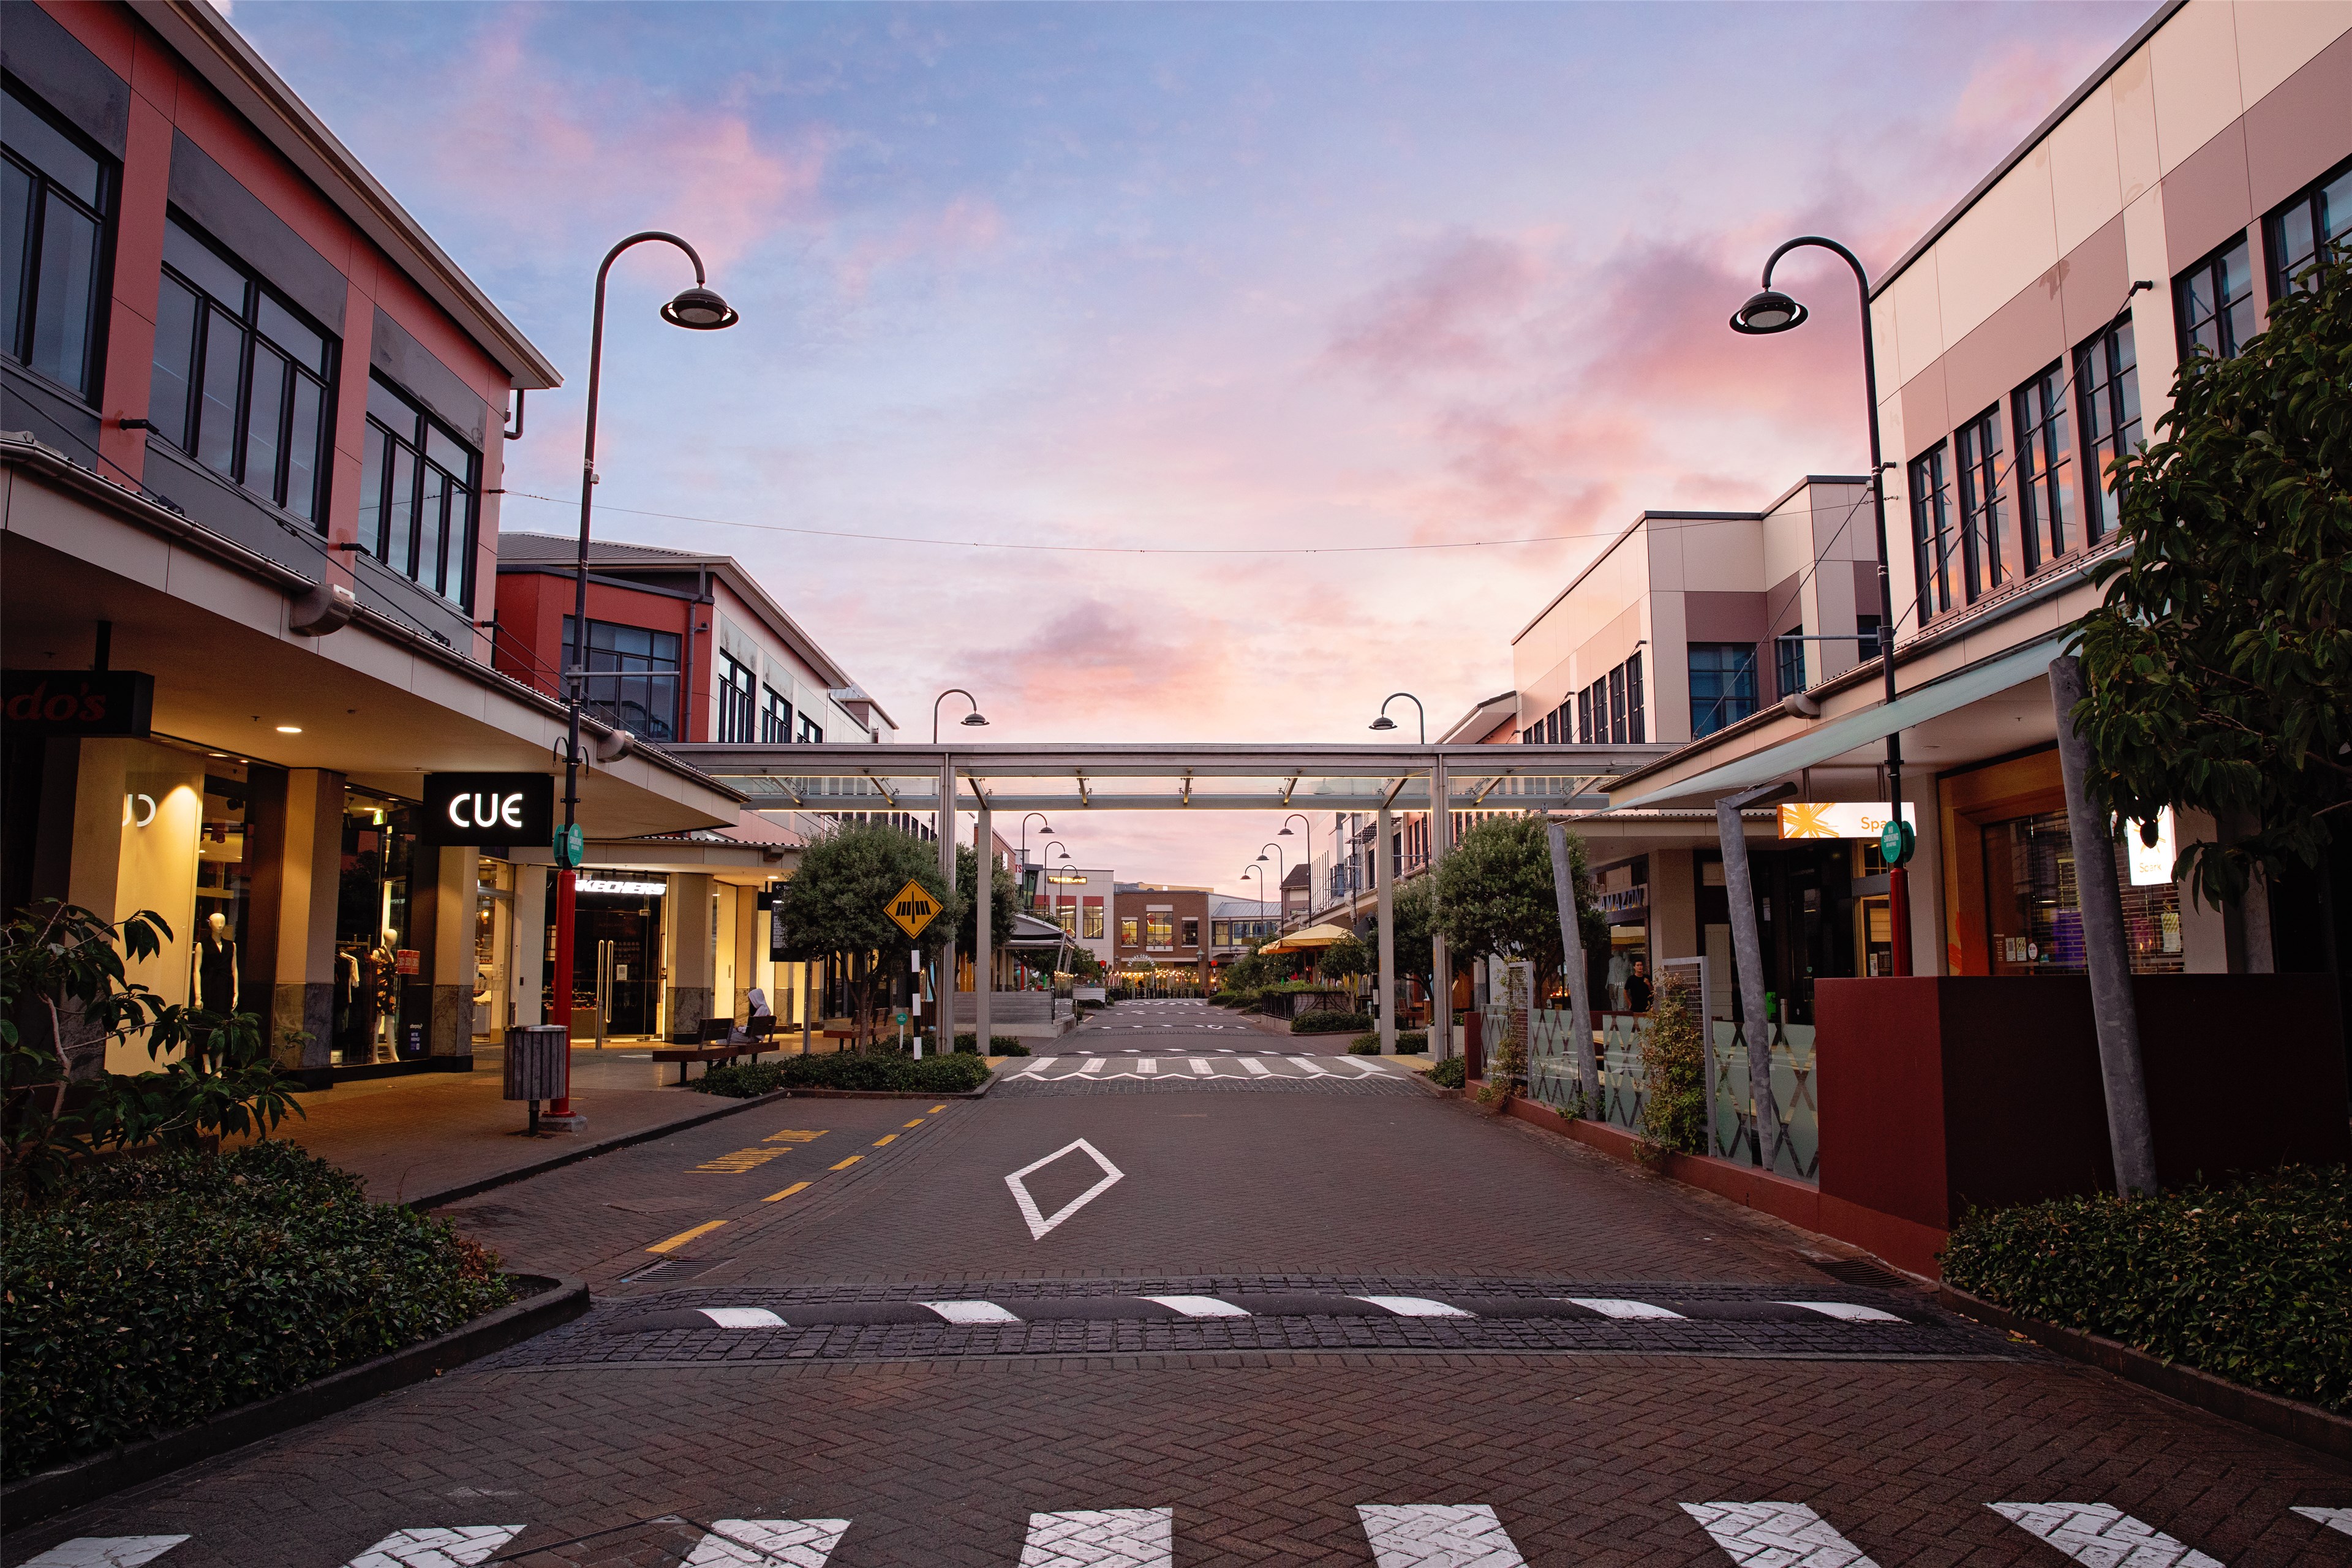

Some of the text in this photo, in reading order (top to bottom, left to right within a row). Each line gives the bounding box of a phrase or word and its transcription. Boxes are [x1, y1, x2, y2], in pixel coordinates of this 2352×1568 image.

[0, 680, 107, 722] do's
[449, 793, 523, 828] CUE
[1861, 816, 1887, 832] Spa
[574, 829, 578, 837] NO
[1883, 832, 1899, 843] SMOKING
[1598, 888, 1644, 912] AMAZON
[1127, 954, 1156, 967] BOTANY COMMONS
